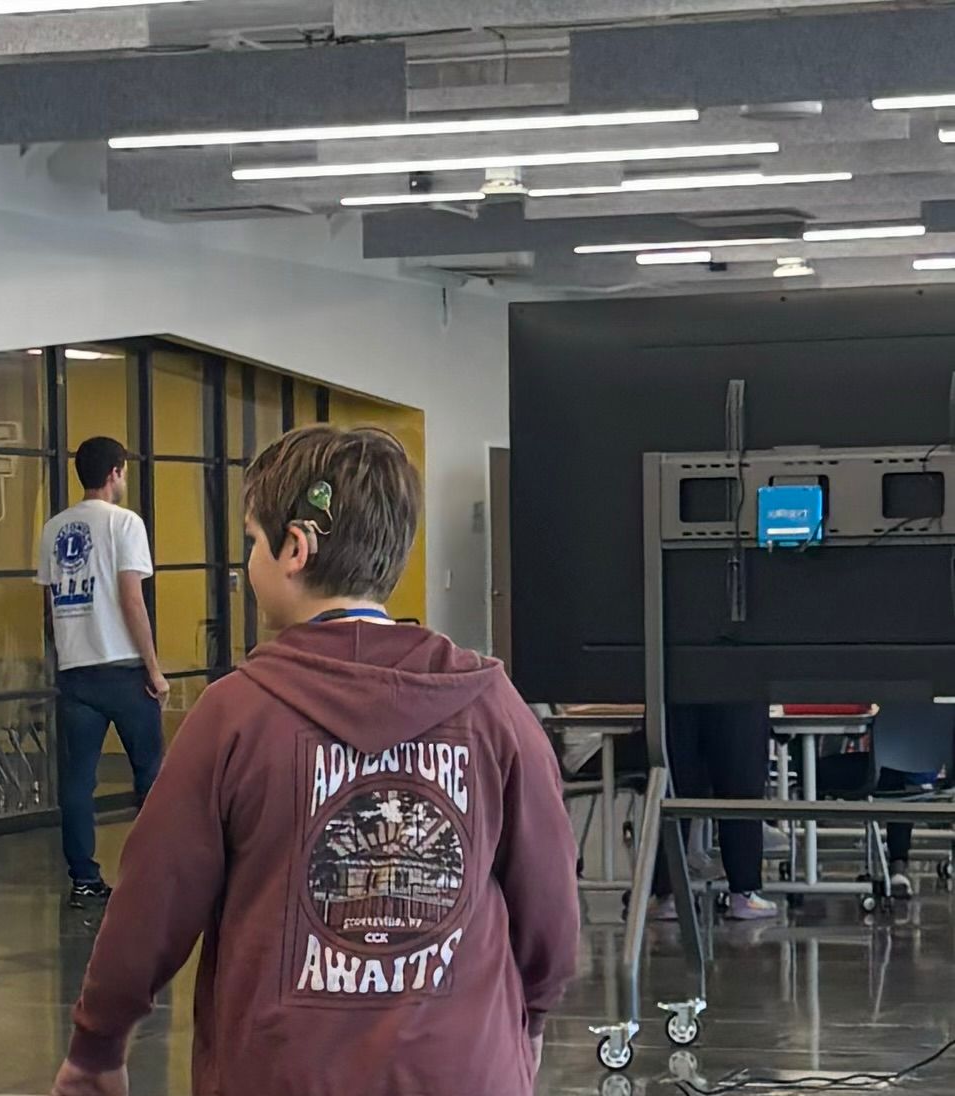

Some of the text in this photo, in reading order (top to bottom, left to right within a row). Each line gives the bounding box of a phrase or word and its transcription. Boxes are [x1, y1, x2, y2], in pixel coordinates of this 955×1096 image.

[66, 537, 78, 556] L
[310, 742, 469, 817] ADVENTURE
[298, 928, 462, 993] AWAITS
